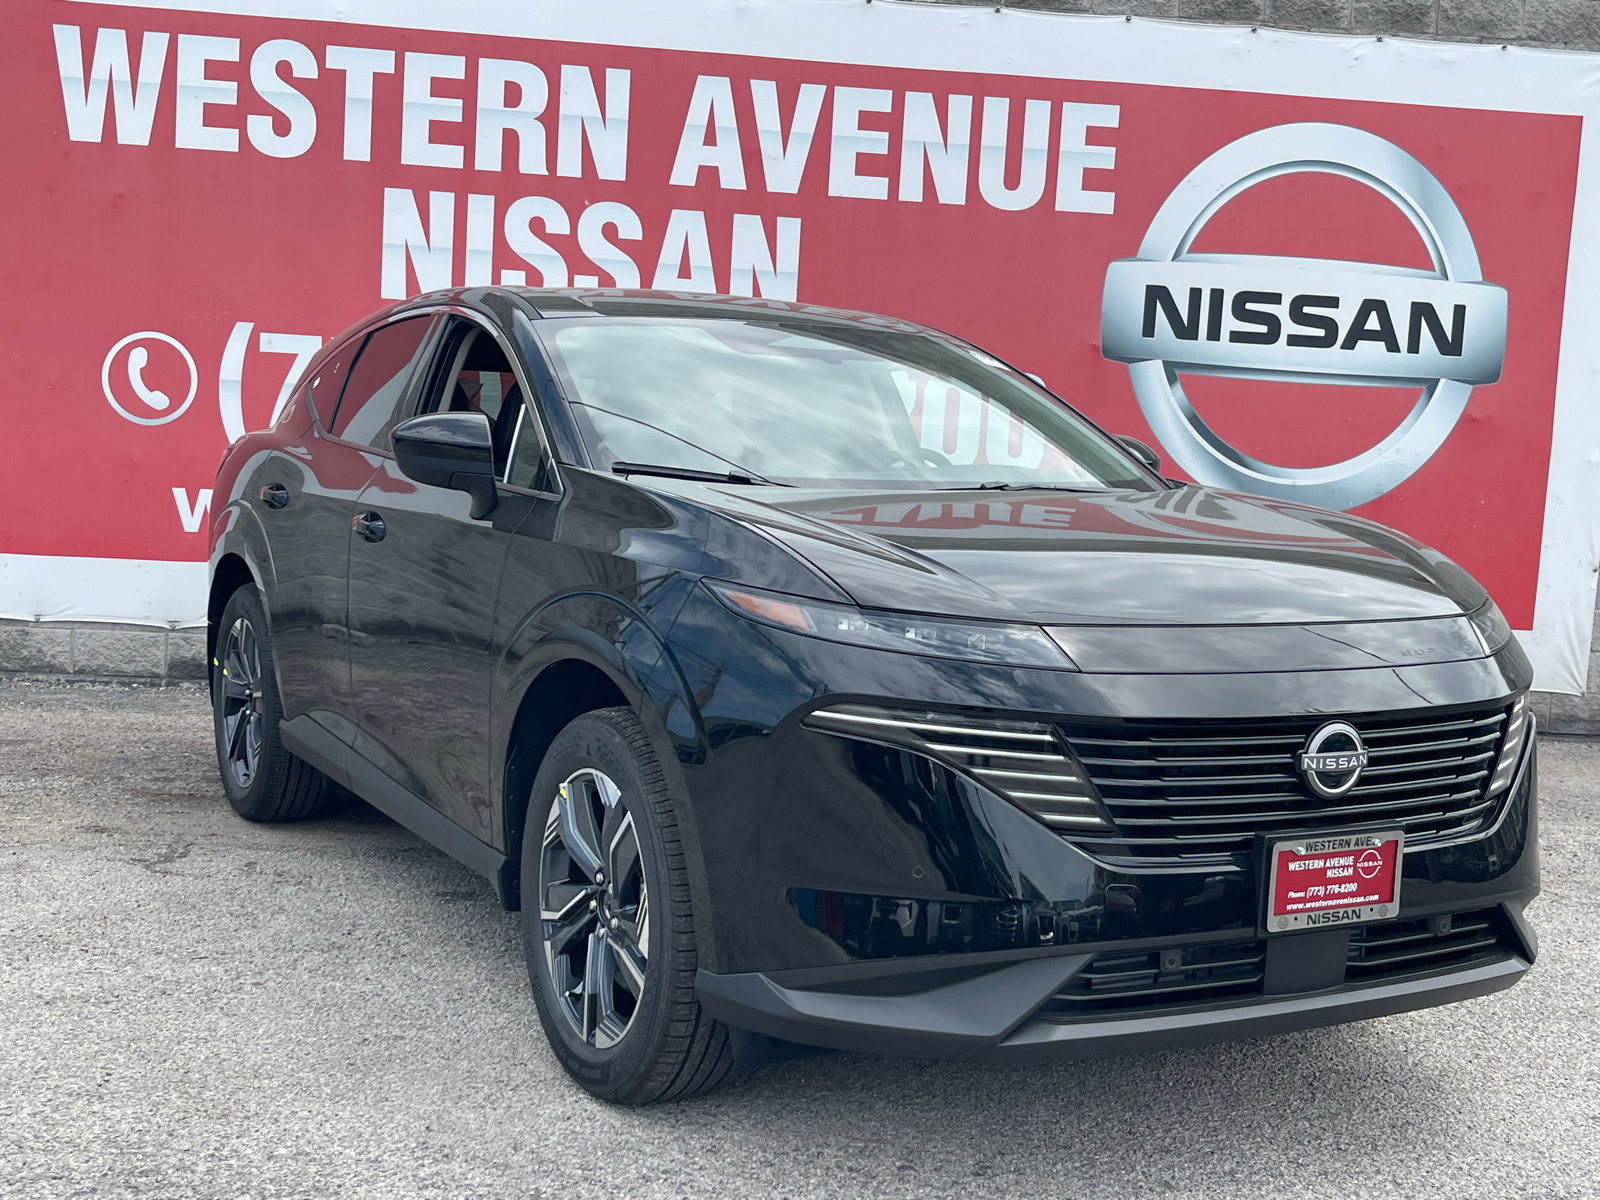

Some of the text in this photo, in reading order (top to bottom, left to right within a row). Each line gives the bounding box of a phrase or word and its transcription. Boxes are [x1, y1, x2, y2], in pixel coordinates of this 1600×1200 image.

[52, 23, 1121, 215] WESTERN AVENUE
[380, 187, 802, 303] NISSAN
[1142, 284, 1467, 357] NISSAN
[1304, 753, 1367, 769] NISSAN
[1305, 838, 1351, 852] WESTERN
[1288, 856, 1355, 871] WESTERN AVENUE
[1357, 860, 1383, 868] NISSAN
[1326, 867, 1354, 878] NISSAN
[1288, 882, 1358, 899] Phone: (773) 776-8200
[1286, 894, 1380, 911] www.westernavenissan.com
[1307, 909, 1362, 926] NISSAN
